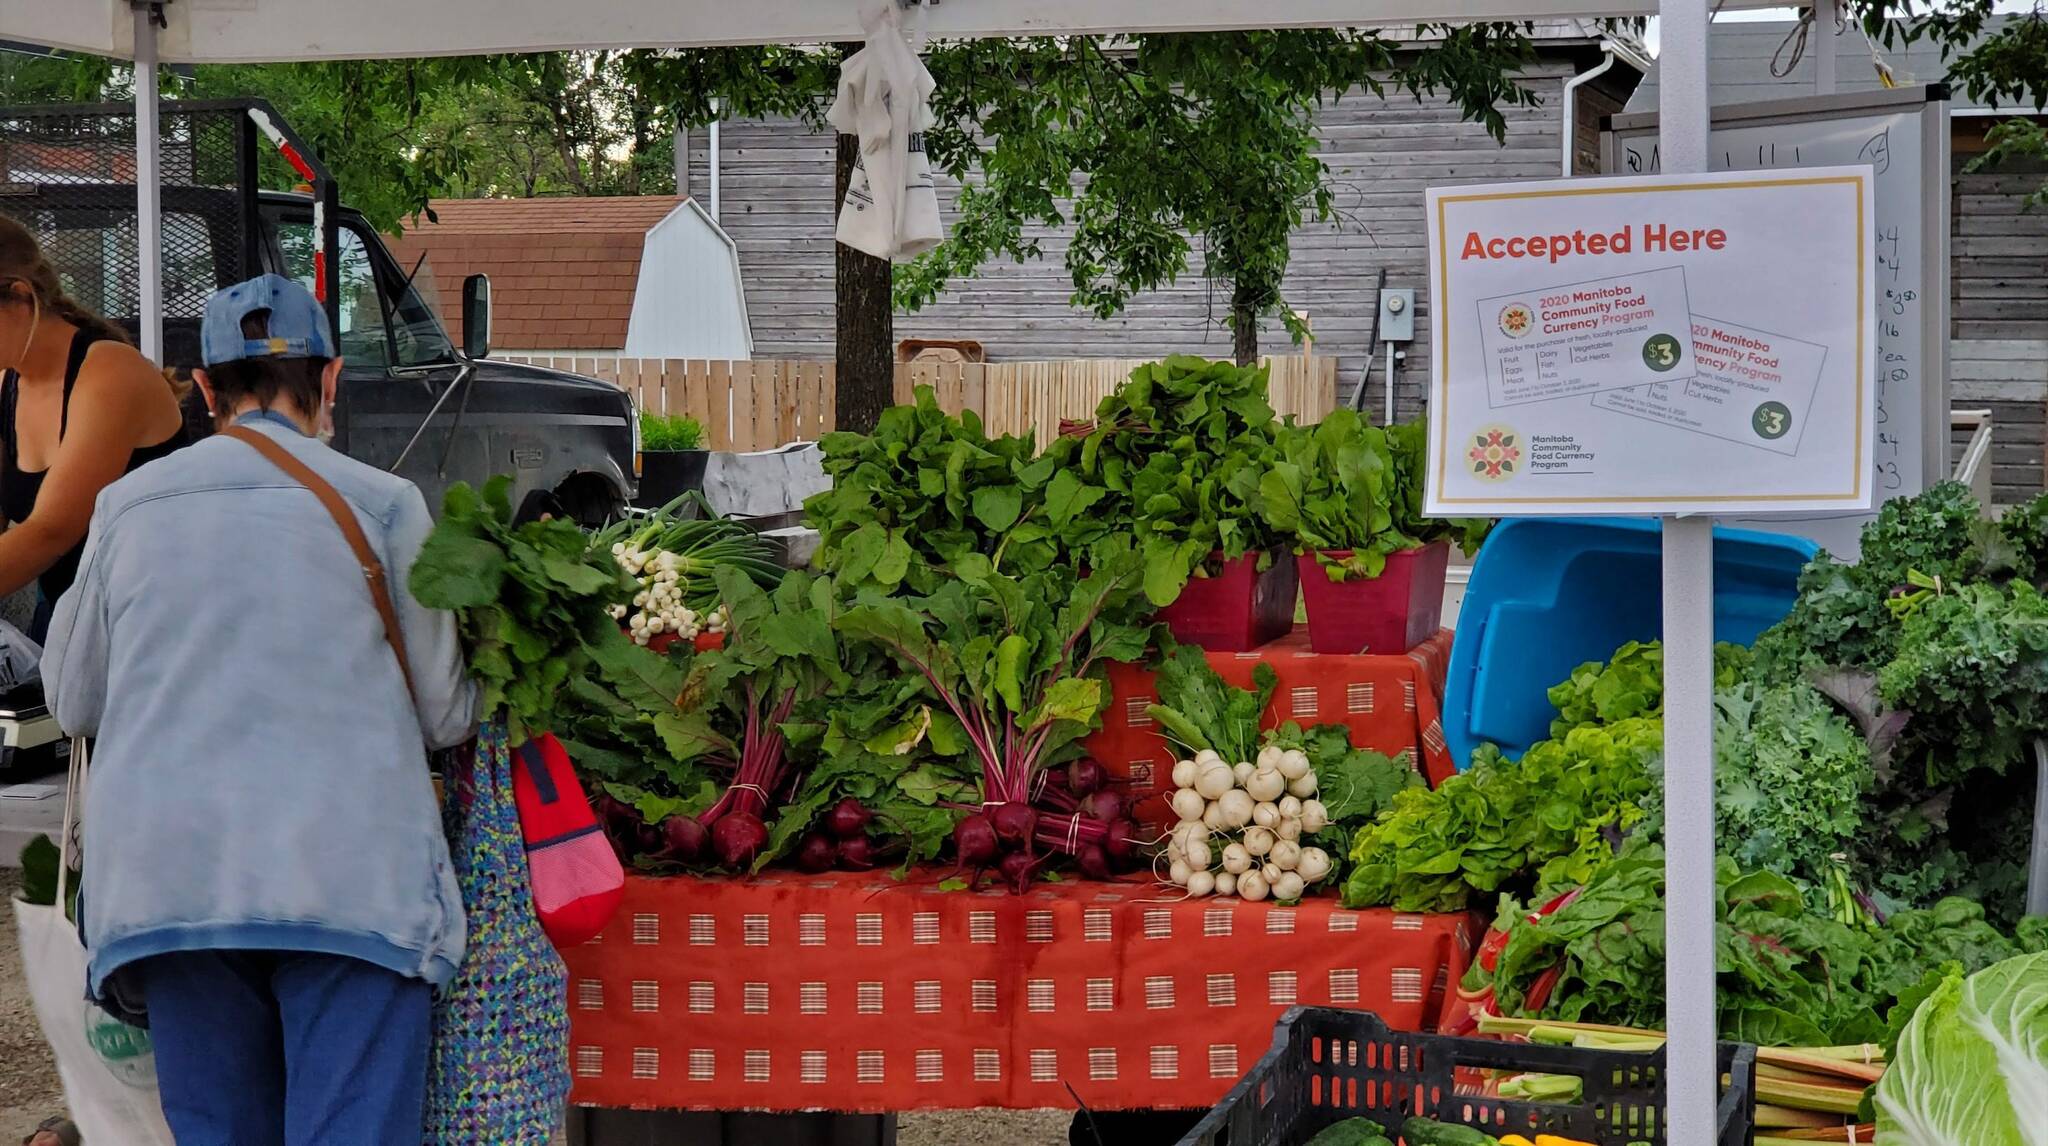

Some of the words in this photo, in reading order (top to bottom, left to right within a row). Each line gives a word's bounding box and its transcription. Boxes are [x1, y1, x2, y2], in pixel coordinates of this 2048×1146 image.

[1460, 225, 1631, 264] Accepted
[1643, 223, 1728, 253] Here
[1539, 294, 1570, 309] 2020
[1572, 286, 1632, 303] Manitoba
[1541, 302, 1612, 322] Community
[1614, 295, 1646, 310] Food
[1543, 318, 1599, 334] Currency
[1602, 308, 1655, 325] Program
[1524, 342, 1536, 350] the
[1537, 338, 1566, 351] purchase
[1711, 328, 1770, 353] Manitoba
[1574, 341, 1614, 353] Vegetables
[1504, 356, 1519, 364] Fruit
[1540, 350, 1558, 358] Dairy
[1574, 355, 1589, 363] Cut
[1589, 353, 1611, 361] Herbs
[1648, 343, 1675, 366] $3
[1747, 352, 1780, 368] Food
[1505, 366, 1522, 375] Eggs
[1541, 361, 1555, 369] Fish
[1542, 371, 1558, 379] Nuts
[1728, 361, 1783, 383] Program
[1692, 379, 1731, 395] Vegetables
[1651, 391, 1668, 402] Nuts
[1688, 389, 1702, 399] Cut
[1702, 393, 1724, 405] Herbs
[1759, 407, 1785, 434] $3
[1531, 435, 1574, 443] Manitoba
[1531, 443, 1582, 452] Community
[1531, 452, 1553, 460] Food
[1555, 451, 1595, 460] Currency
[1530, 461, 1569, 469] Program
